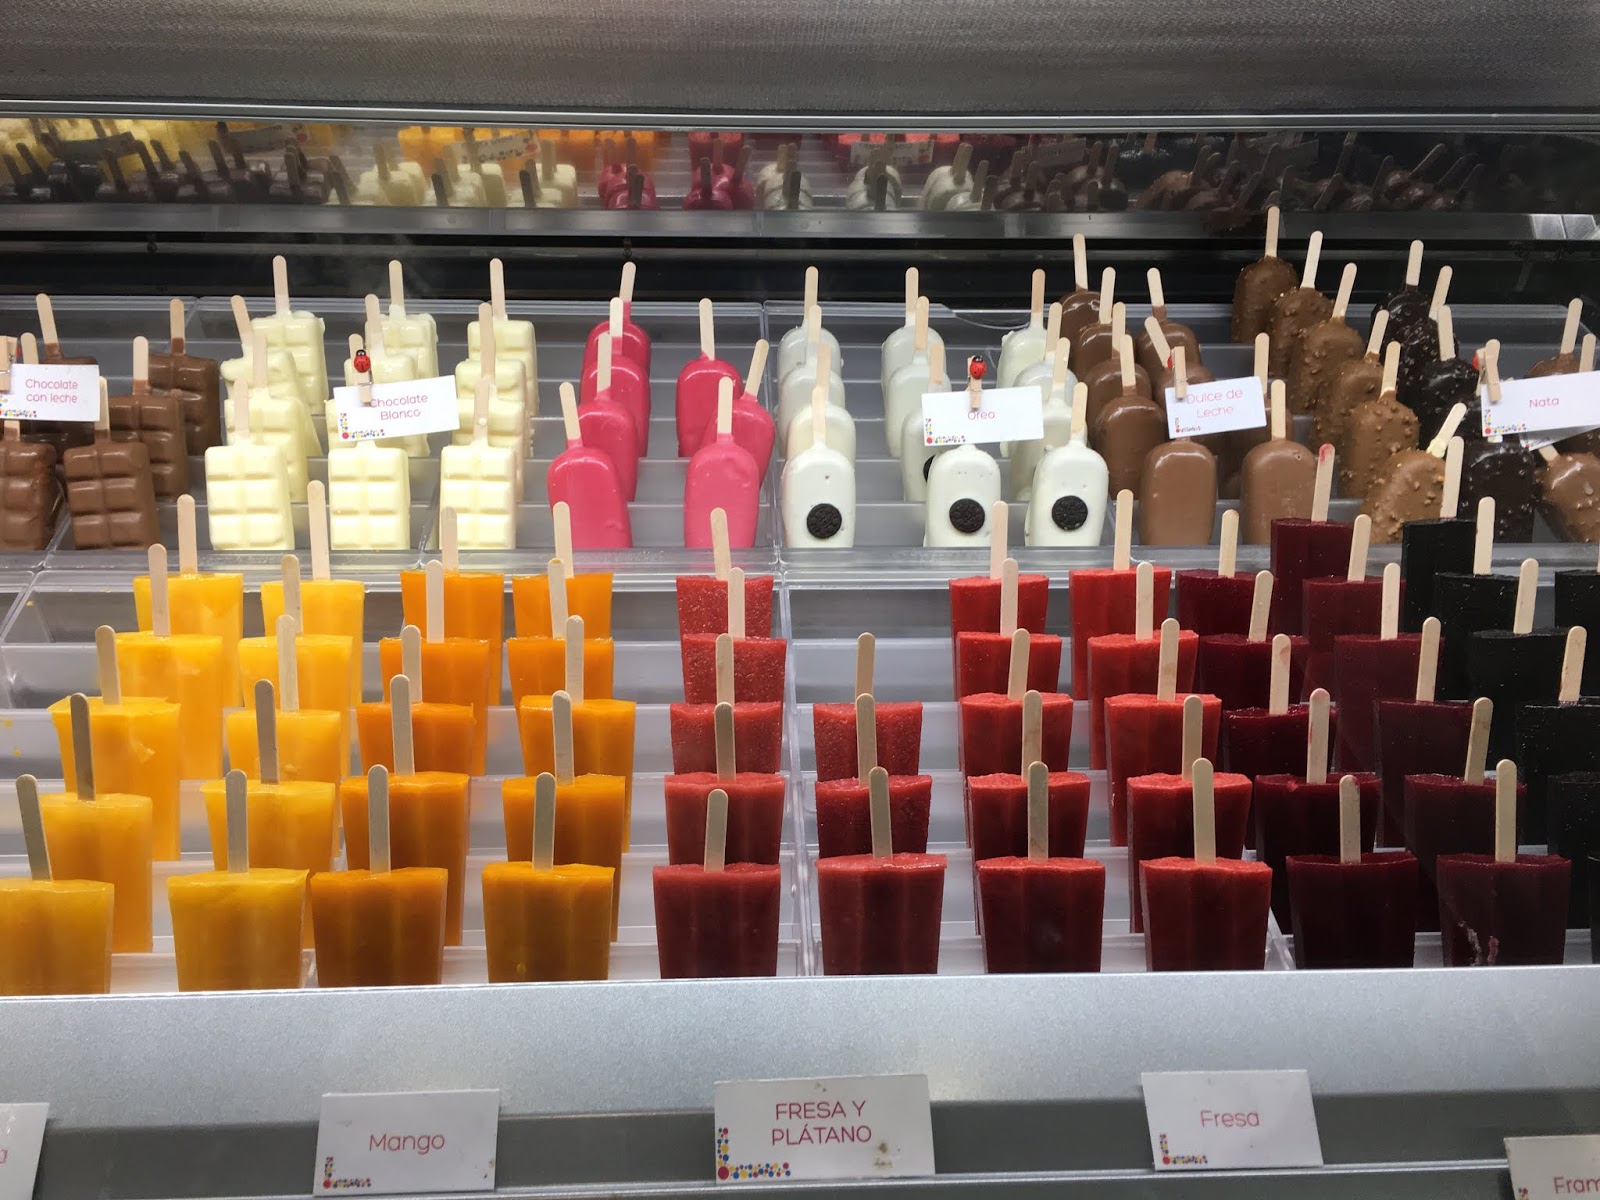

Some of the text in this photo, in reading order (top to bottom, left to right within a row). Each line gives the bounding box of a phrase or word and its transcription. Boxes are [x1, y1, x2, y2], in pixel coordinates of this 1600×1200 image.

[25, 379, 79, 390] Chocolate
[26, 394, 78, 403] con leche
[370, 394, 428, 408] Chocolate
[1187, 389, 1243, 404] Dulce de
[1529, 396, 1560, 408] Nata
[380, 408, 421, 420] Blanco
[968, 410, 995, 421] Oreo
[1197, 405, 1234, 418] Leche
[775, 1100, 866, 1120] FRESA Y
[1200, 1110, 1260, 1127] Fresa
[772, 1124, 872, 1146] PLÁTANO
[369, 1134, 446, 1155] Mango
